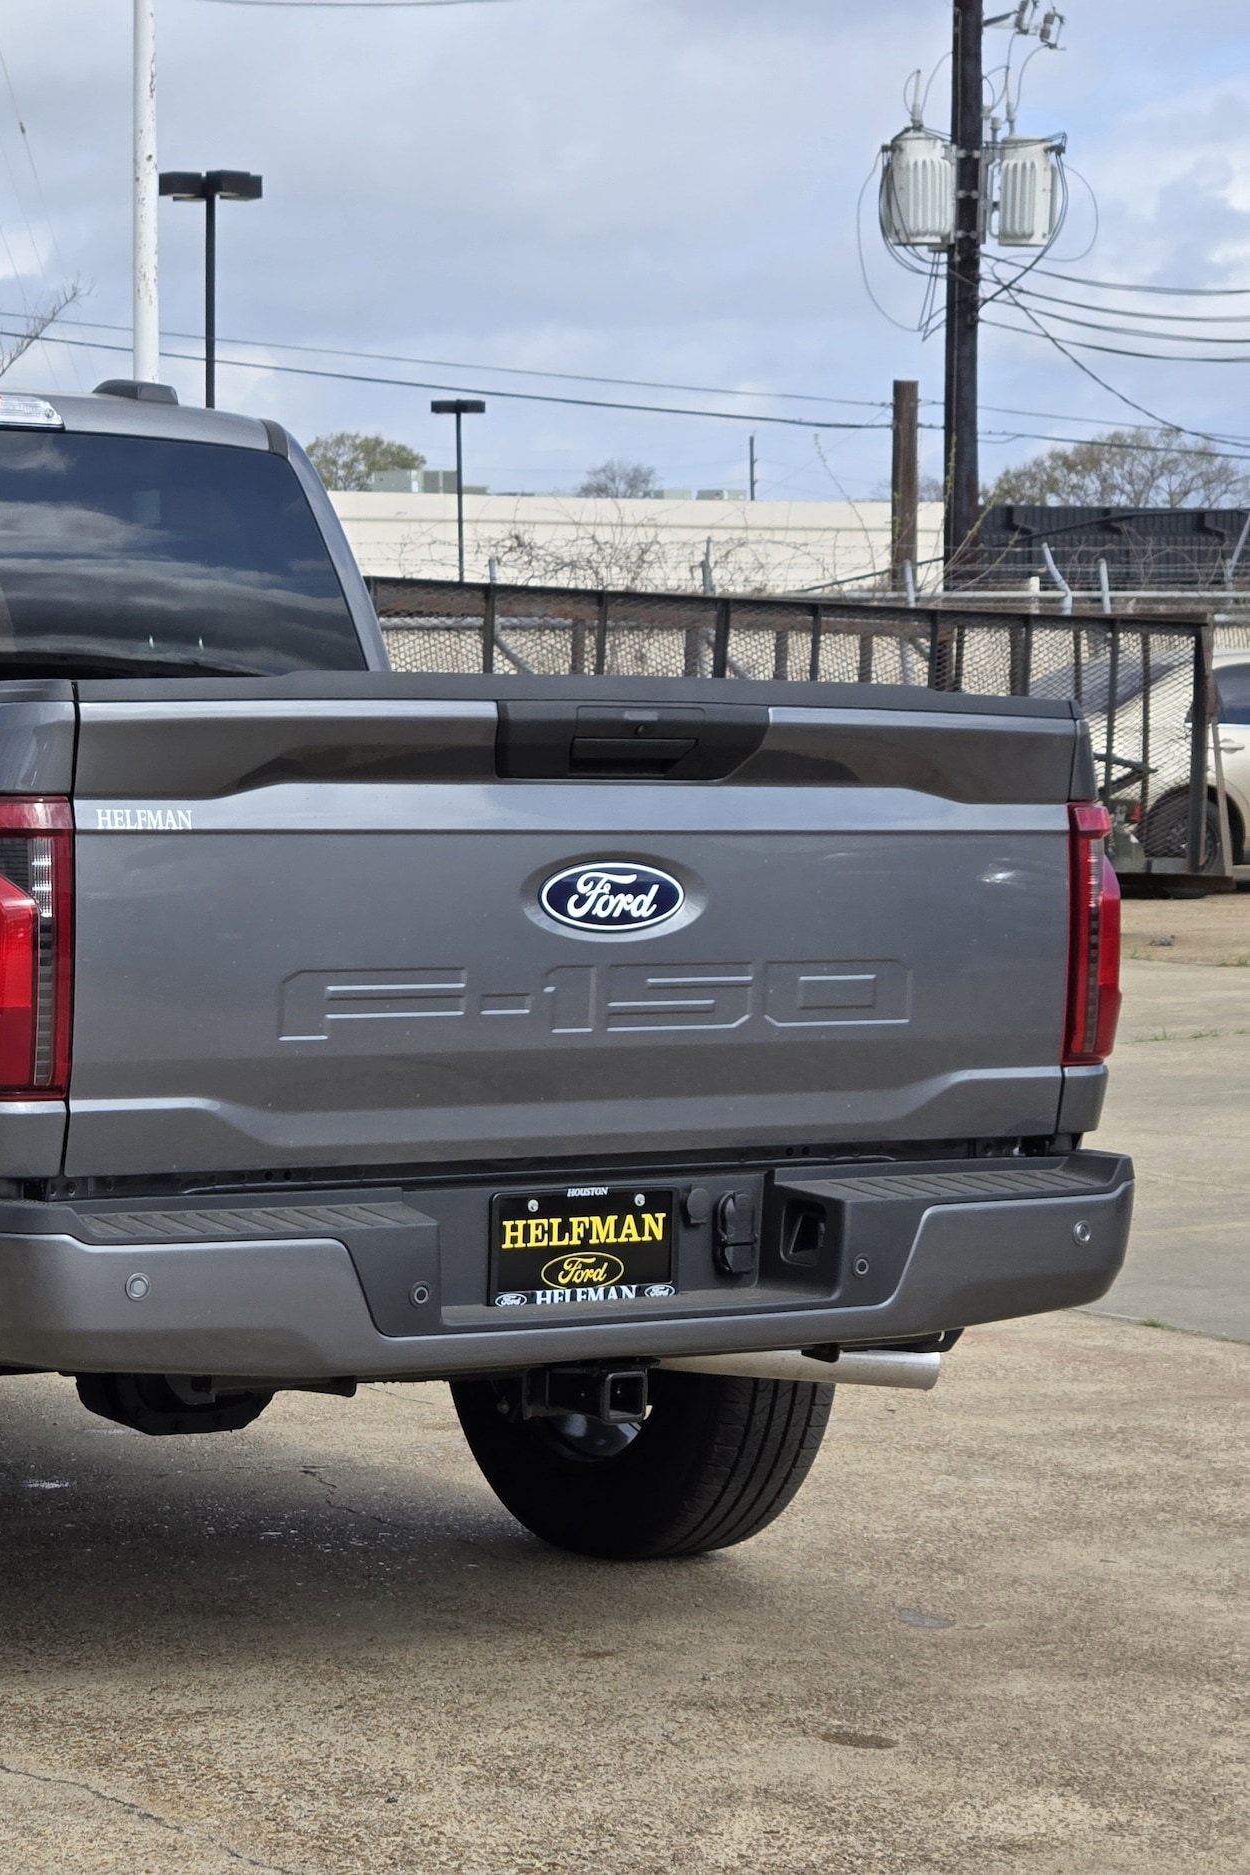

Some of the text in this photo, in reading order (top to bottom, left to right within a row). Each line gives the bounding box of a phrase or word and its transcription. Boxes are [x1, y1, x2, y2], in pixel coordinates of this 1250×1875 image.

[95, 808, 193, 831] HELFMAN
[566, 871, 660, 919] Ford
[278, 957, 913, 1041] F-150
[566, 1186, 609, 1198] HOUSTON
[501, 1212, 667, 1249] HELFMAN
[557, 1256, 609, 1285] Ford
